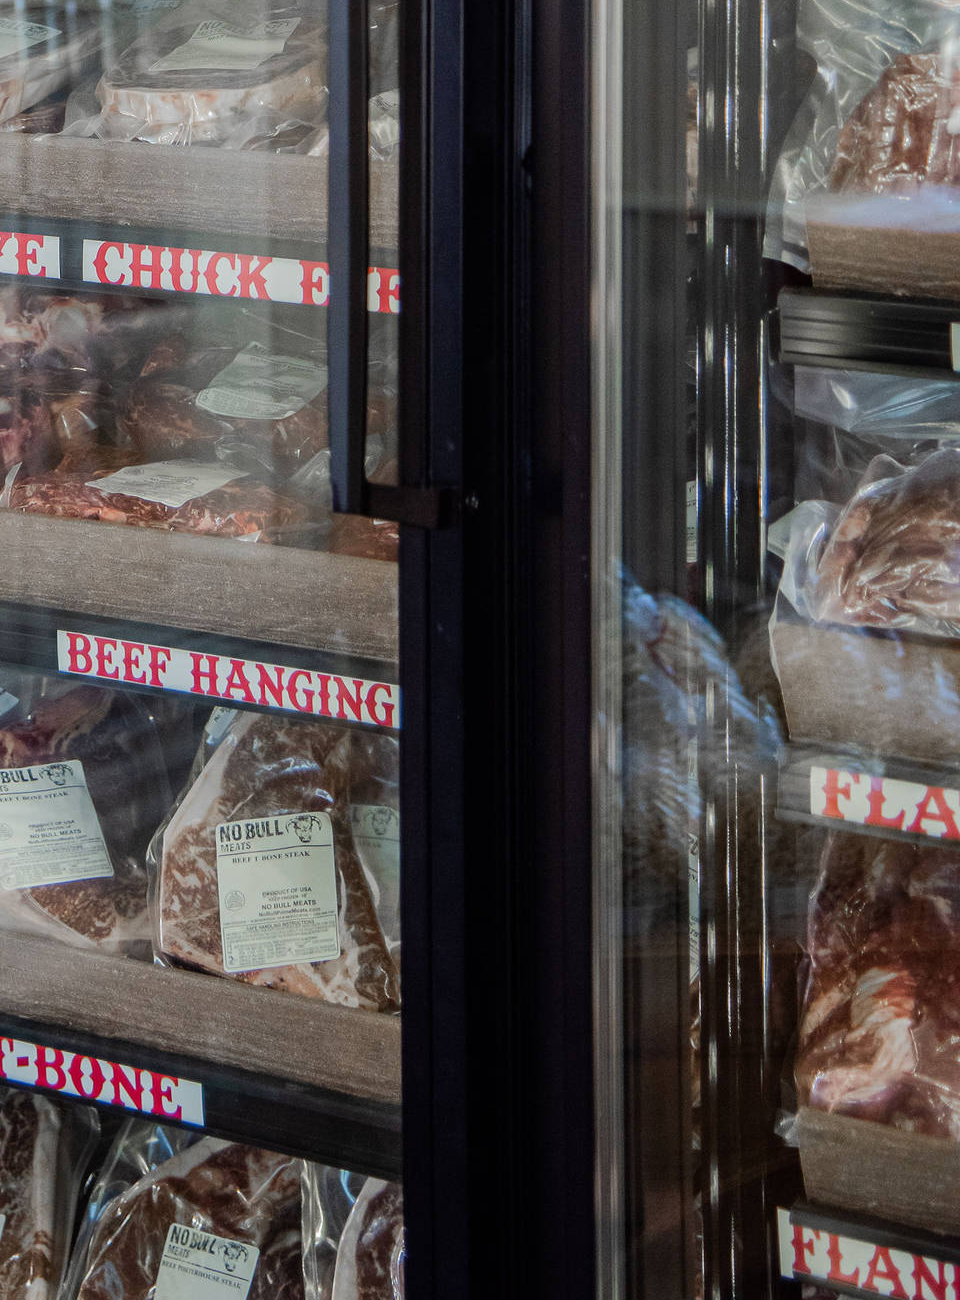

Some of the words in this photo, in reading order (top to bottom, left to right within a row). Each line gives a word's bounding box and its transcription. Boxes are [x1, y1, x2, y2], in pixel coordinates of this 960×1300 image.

[94, 241, 268, 300] CHUCK
[299, 260, 399, 313] EE
[67, 632, 172, 688] BEEF
[190, 651, 397, 728] HANGING
[0, 768, 38, 783] BULL
[822, 769, 960, 840] FLA
[220, 823, 241, 842] NO
[245, 820, 284, 840] BULL
[220, 841, 252, 852] MEATS
[170, 1226, 190, 1246] NO
[189, 1233, 217, 1254] BULL
[792, 1224, 960, 1300] FLAN
